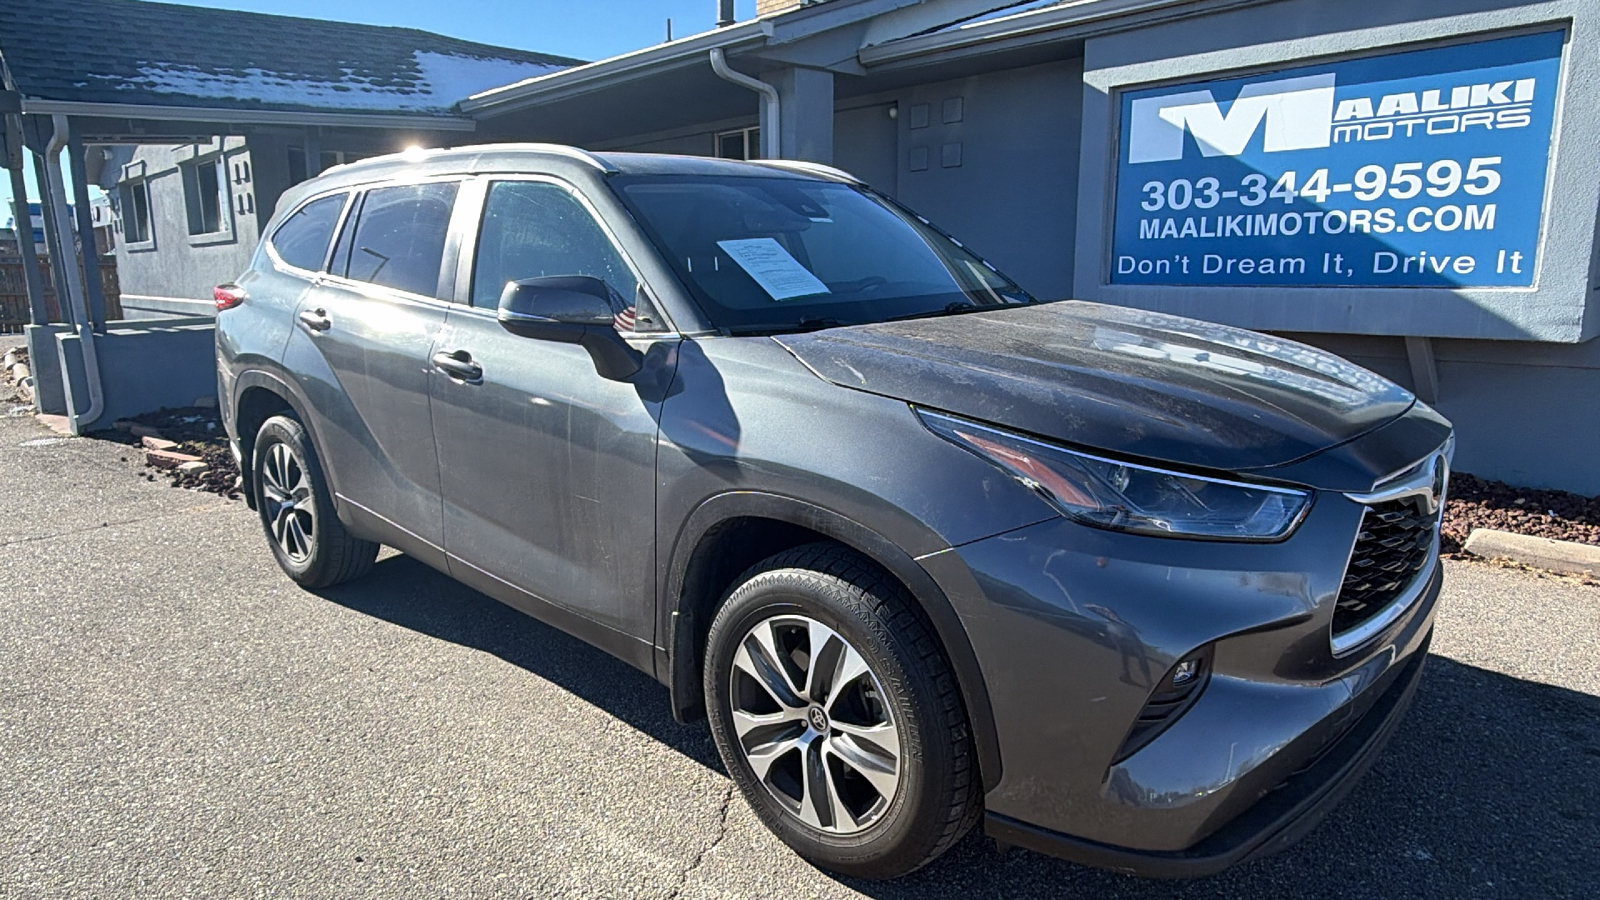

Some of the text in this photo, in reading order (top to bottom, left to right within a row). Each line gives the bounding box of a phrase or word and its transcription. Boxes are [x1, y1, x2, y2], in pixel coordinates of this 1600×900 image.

[1332, 107, 1532, 144] MOTORS
[1141, 156, 1502, 212] 303-344-9595
[1139, 203, 1497, 240] MAALIKIMOTORS.COM
[1117, 249, 1524, 278] Don't Dream It, Drive It
